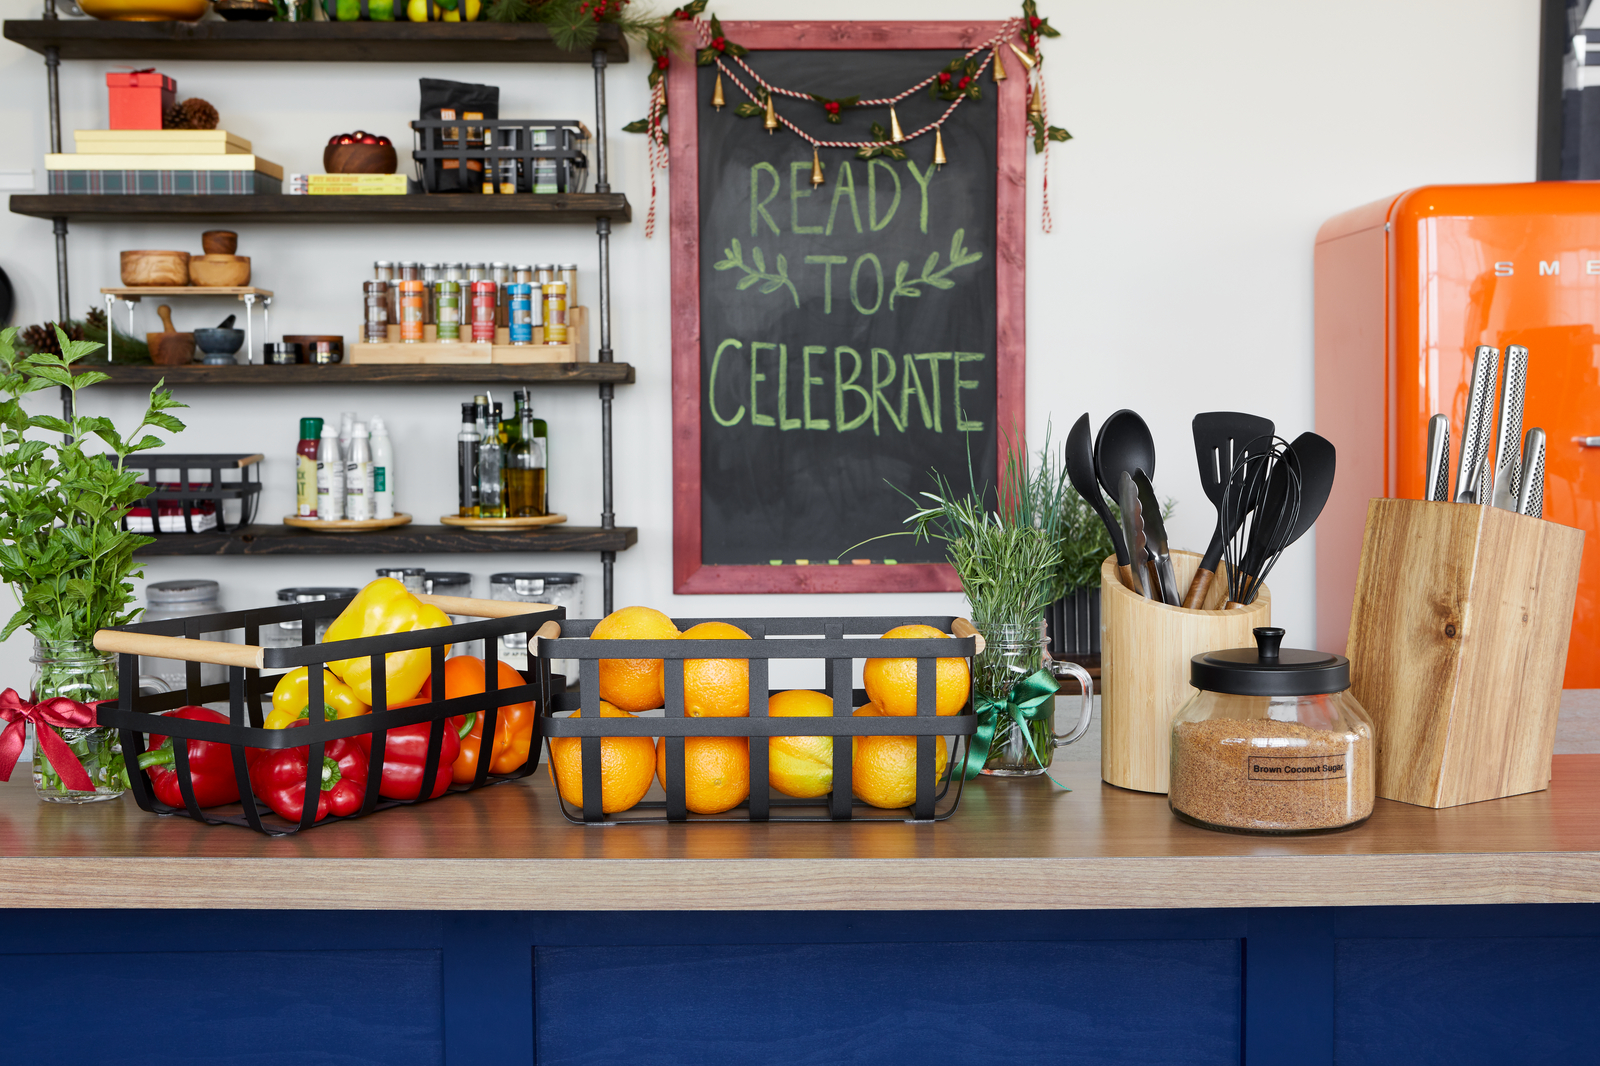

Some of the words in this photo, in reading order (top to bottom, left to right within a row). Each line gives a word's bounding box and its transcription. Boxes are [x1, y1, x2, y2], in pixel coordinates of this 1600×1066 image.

[751, 159, 937, 236] READY
[804, 252, 884, 315] TO
[1494, 260, 1600, 277] SME
[709, 338, 985, 436] CELEBRATE
[1253, 764, 1282, 773] Brown
[1284, 765, 1320, 774] Coconut
[1322, 764, 1344, 773] Sugar
